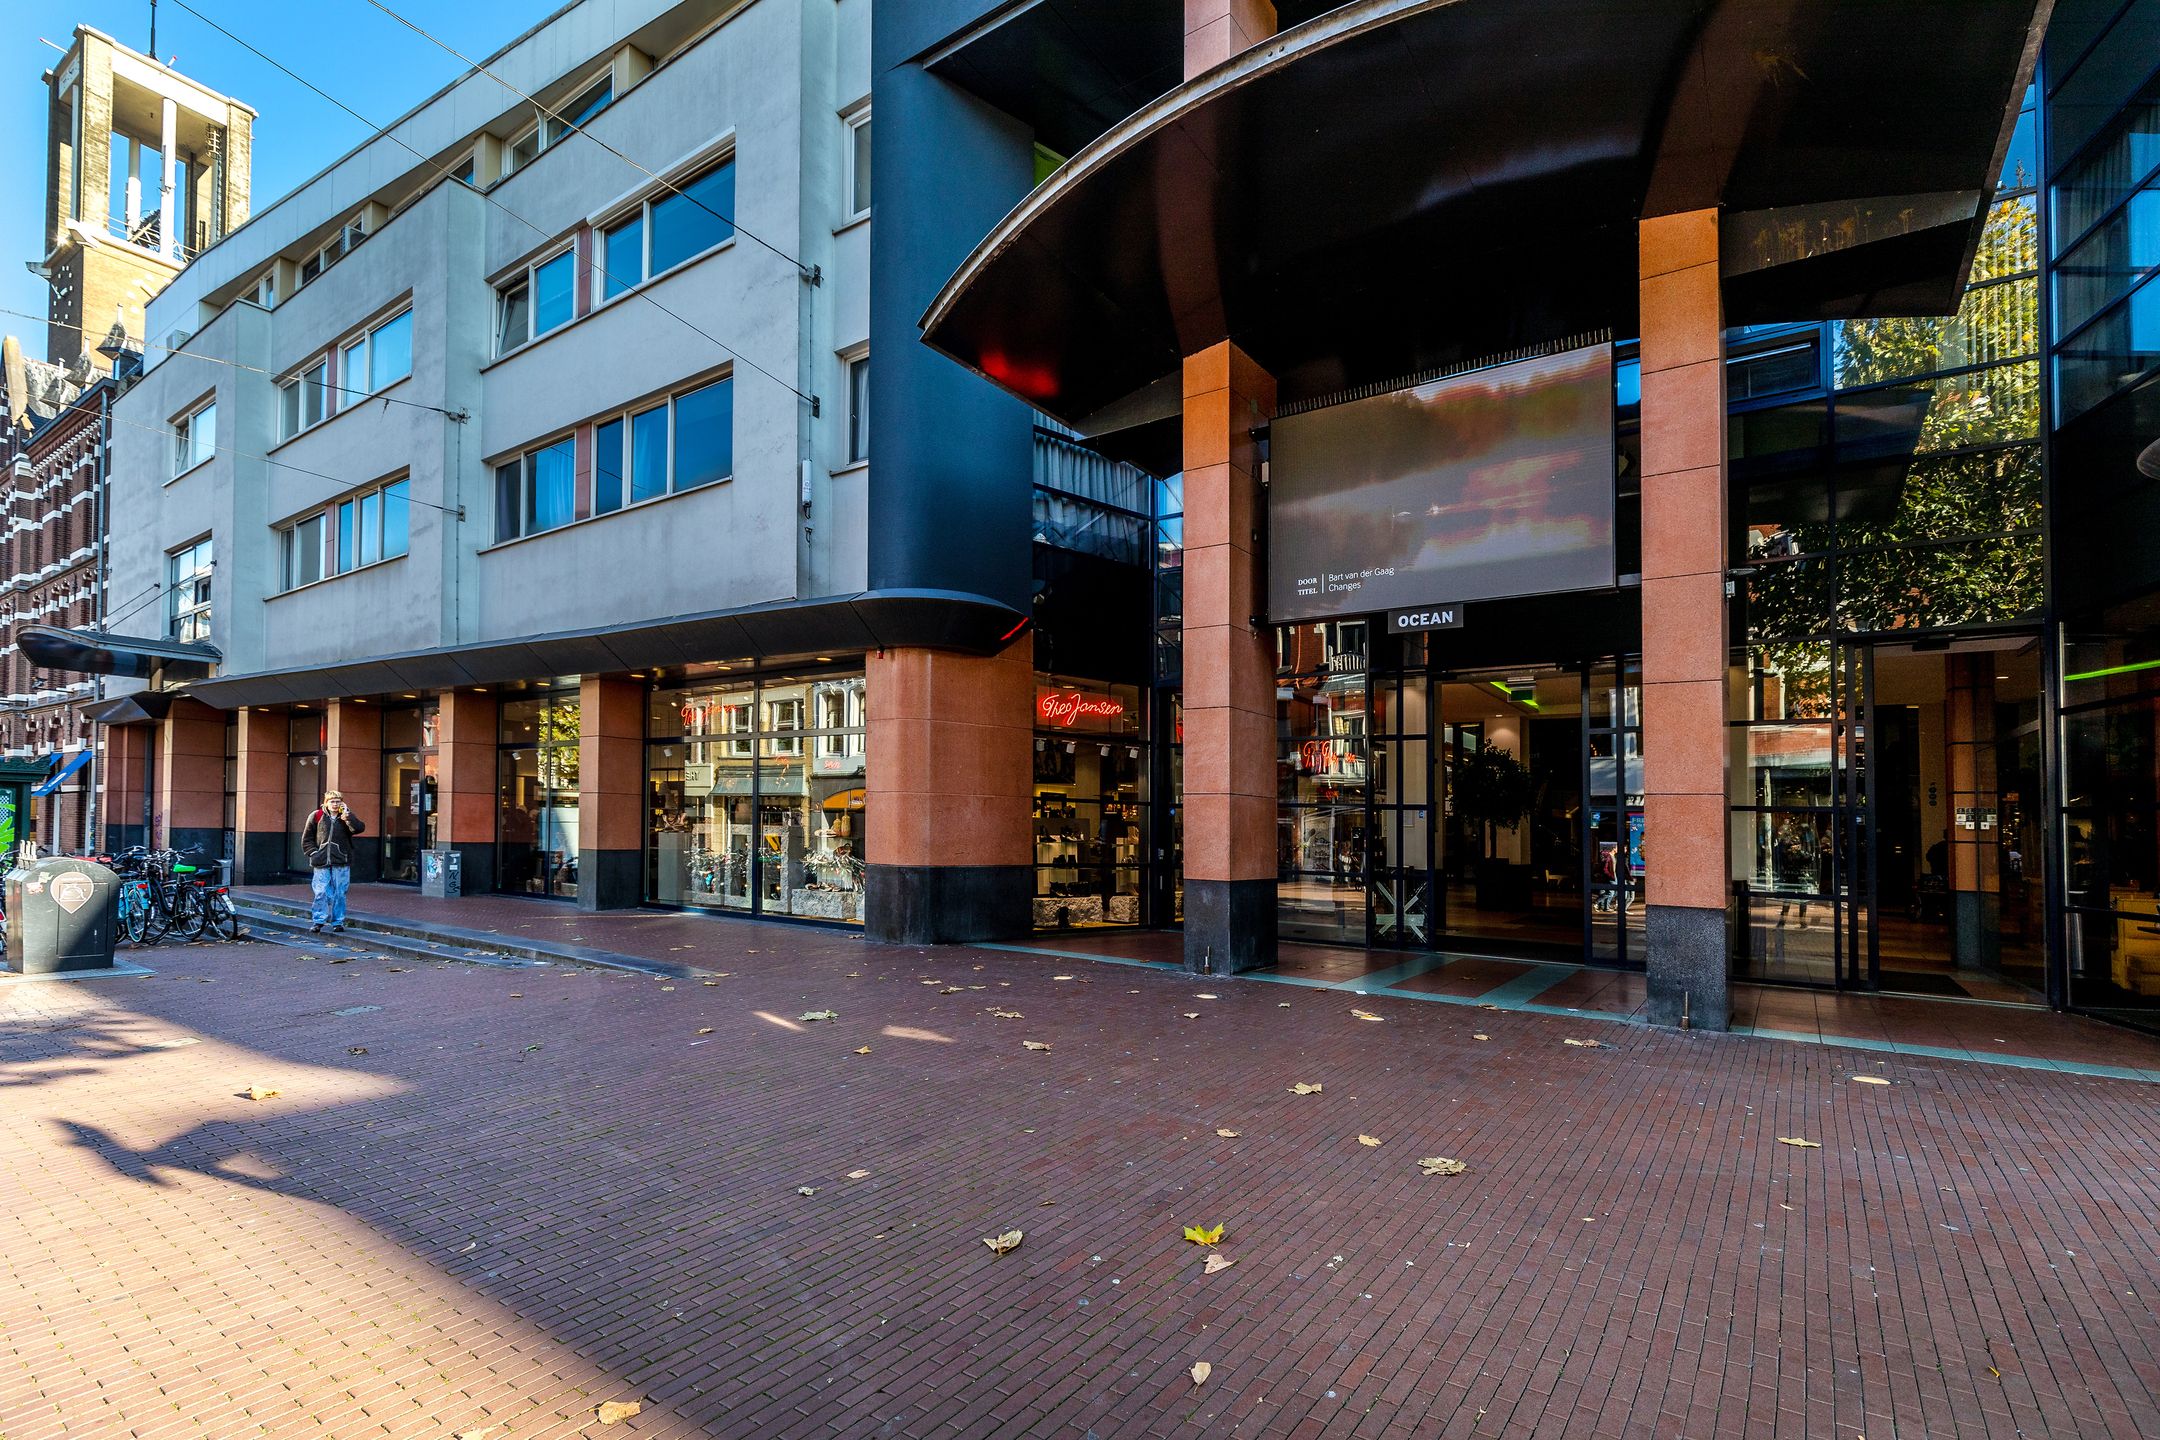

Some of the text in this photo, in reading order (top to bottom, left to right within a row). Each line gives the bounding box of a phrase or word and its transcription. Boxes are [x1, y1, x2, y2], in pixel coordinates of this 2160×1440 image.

[1328, 573, 1343, 582] Bart
[1360, 570, 1373, 578] der
[1374, 567, 1395, 576] Gaag
[1298, 577, 1318, 586] DOOR
[1328, 582, 1361, 592] Changes
[1298, 588, 1318, 596] TITEL
[1398, 611, 1453, 628] OCEAN
[1042, 693, 1123, 726] Theo Jansen
